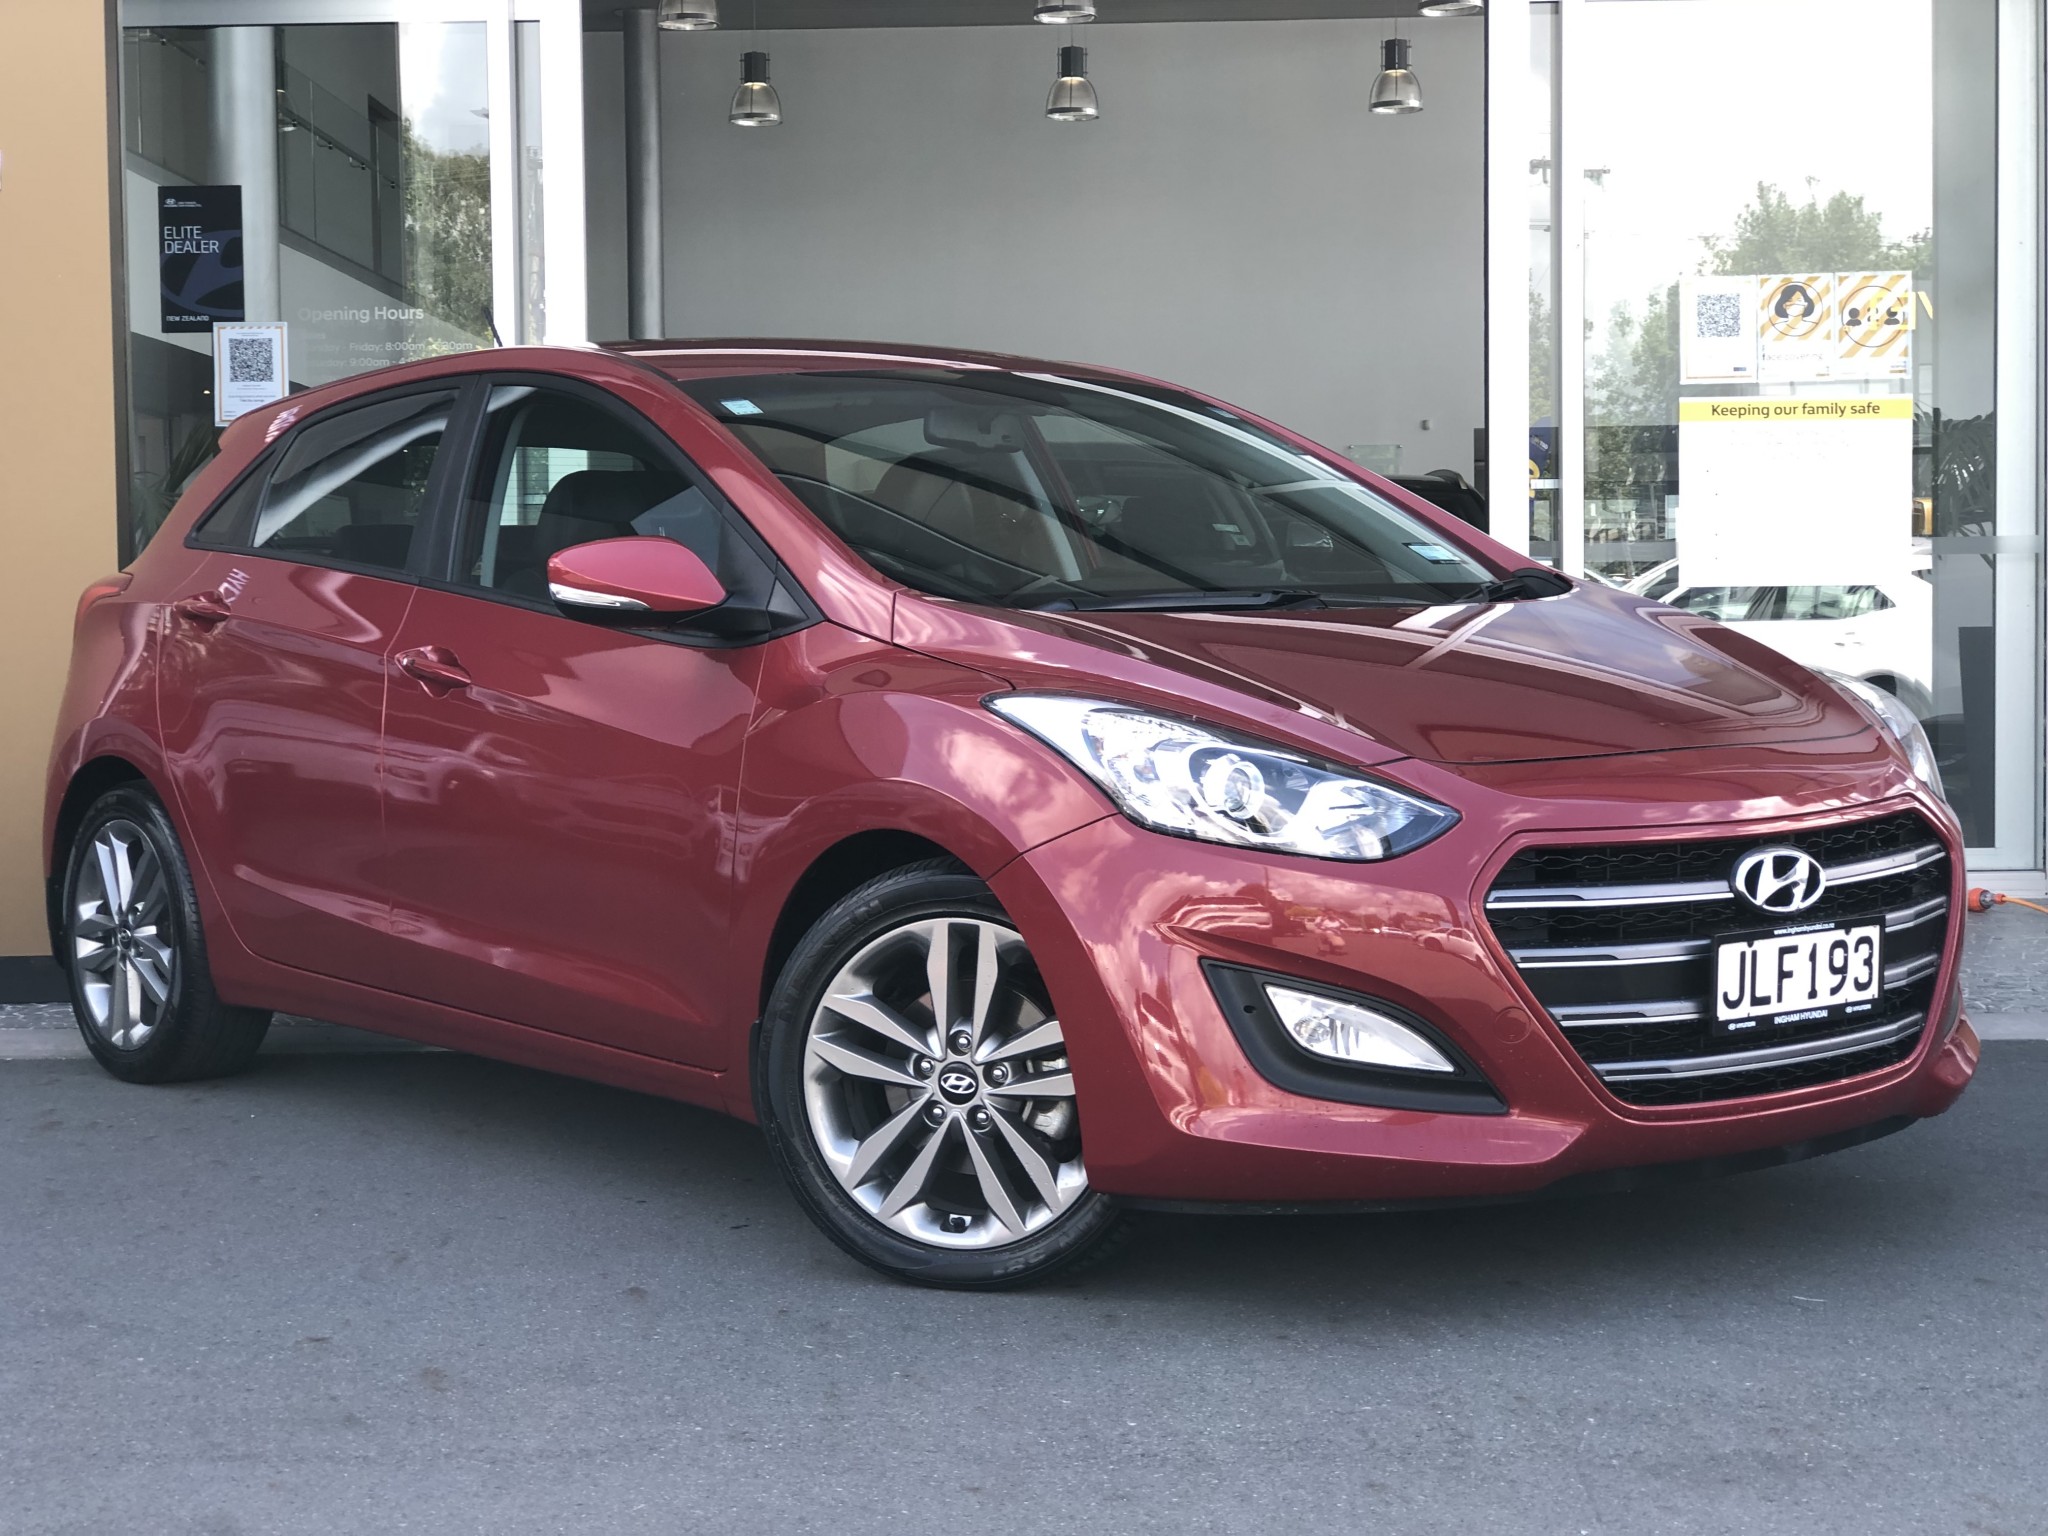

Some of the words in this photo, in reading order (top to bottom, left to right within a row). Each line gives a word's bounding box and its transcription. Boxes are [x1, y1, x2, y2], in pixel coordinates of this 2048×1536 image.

[164, 226, 202, 239] ELITE
[164, 240, 220, 254] DEALER
[297, 306, 371, 324] Opening
[374, 306, 425, 321] Hours
[1711, 404, 1770, 419] Keeping
[1774, 405, 1799, 416] our
[1802, 402, 1847, 417] family
[1850, 402, 1881, 414] safe
[1722, 935, 1875, 1010] JLF193
[1774, 1012, 1800, 1024] INGHAM
[1800, 1010, 1828, 1020] HYUNDAI
